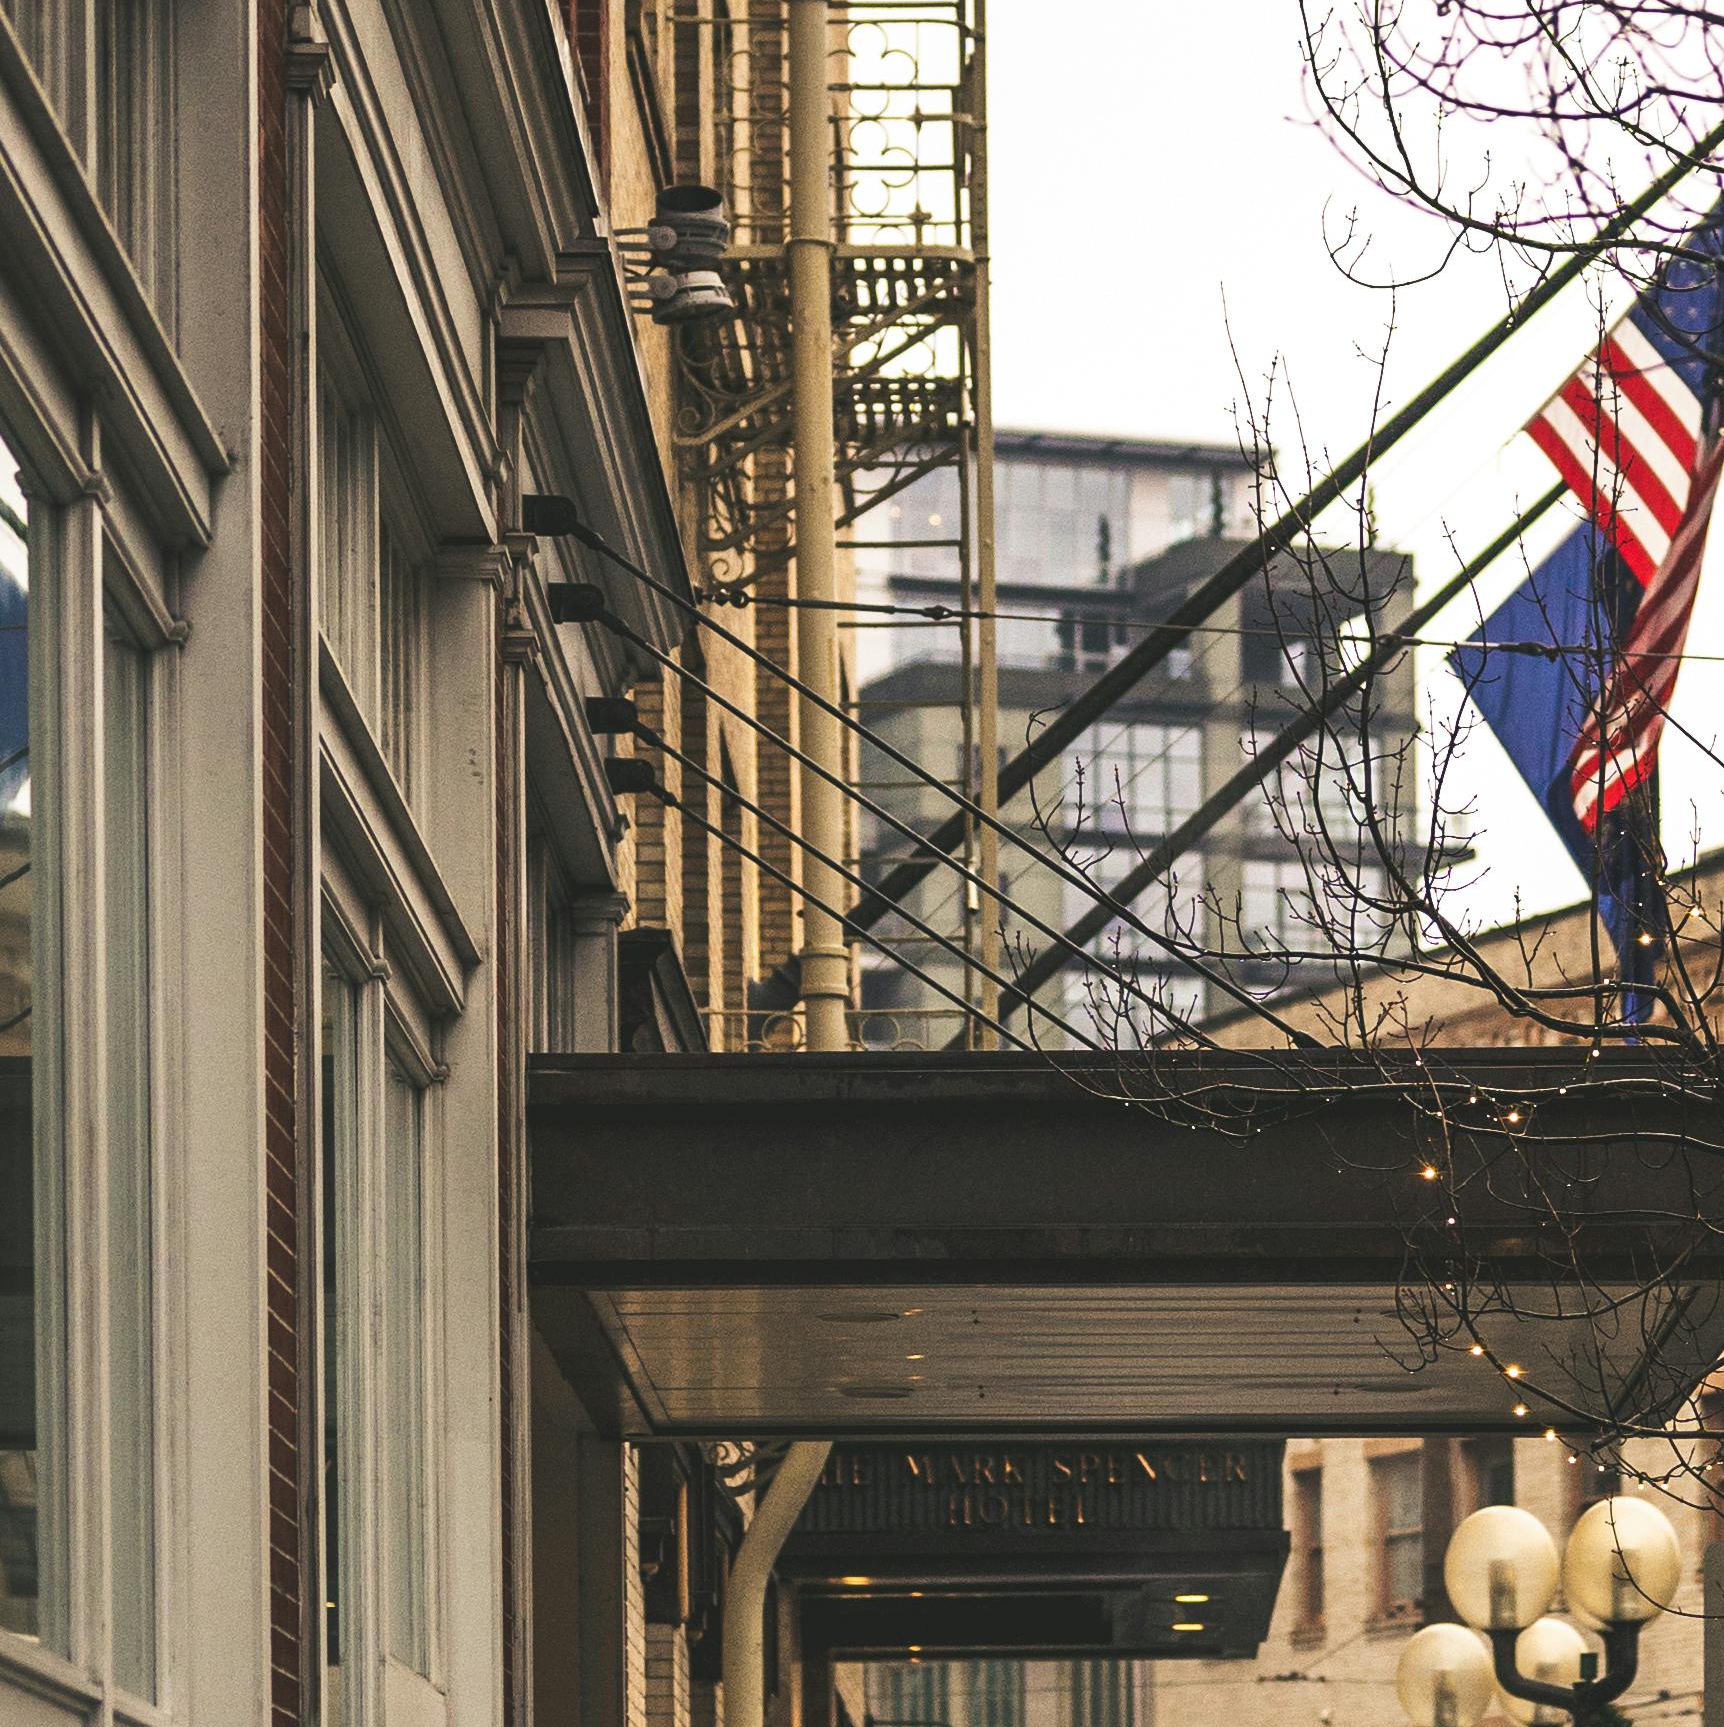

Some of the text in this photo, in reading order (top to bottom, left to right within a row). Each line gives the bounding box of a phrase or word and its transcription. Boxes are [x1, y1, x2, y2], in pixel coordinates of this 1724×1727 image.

[904, 1454, 1024, 1484] MARK
[1054, 1452, 1248, 1484] SPENCER
[948, 1494, 1089, 1525] HOTEL
